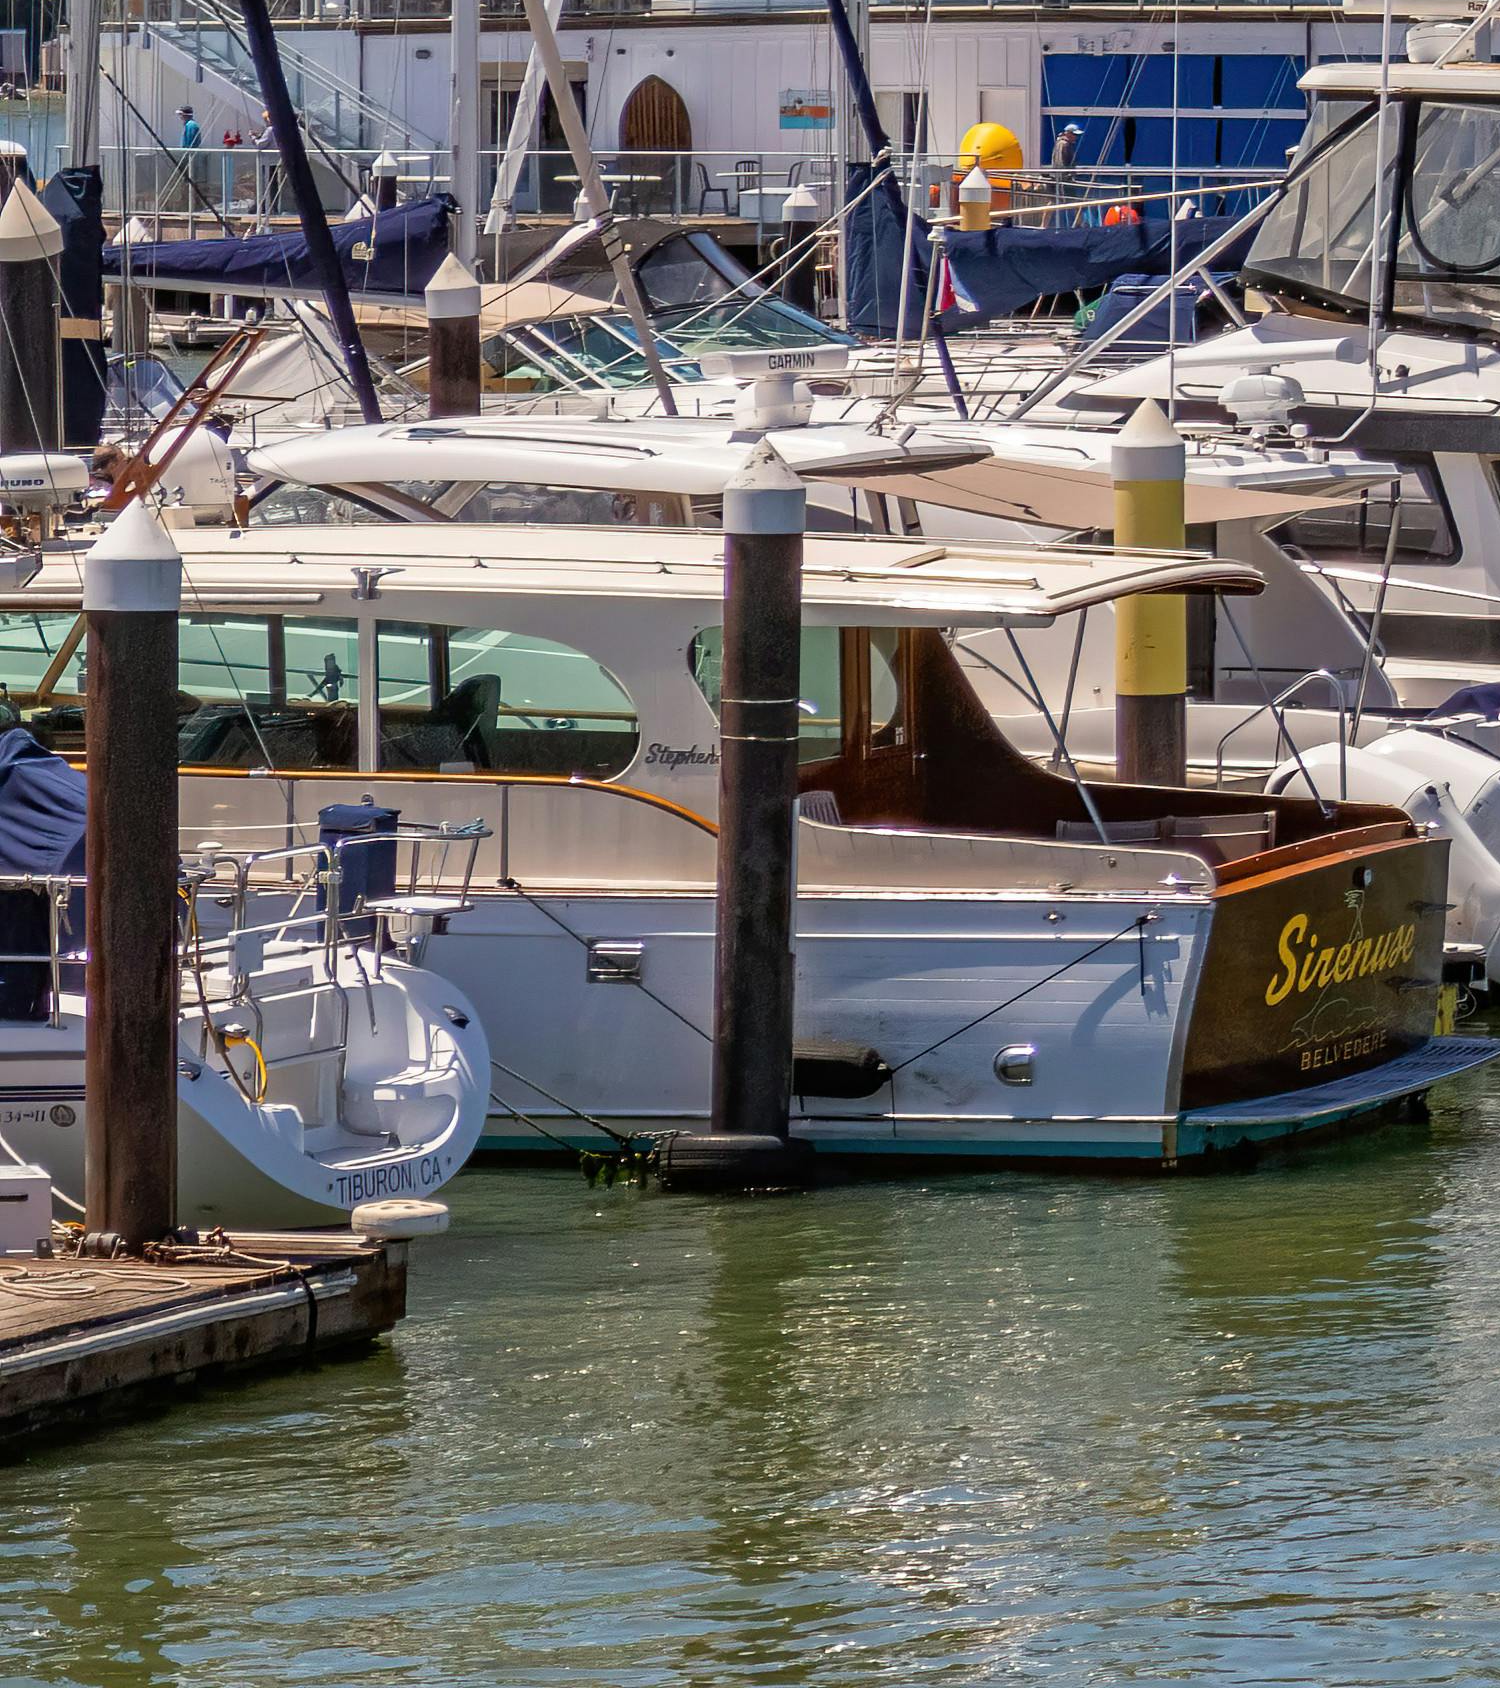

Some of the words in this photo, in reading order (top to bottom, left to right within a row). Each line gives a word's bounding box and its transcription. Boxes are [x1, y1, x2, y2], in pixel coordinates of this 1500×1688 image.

[768, 352, 815, 370] GARMIN
[1265, 913, 1416, 1006] Sirenuse
[1300, 1029, 1388, 1071] BELVEDERE
[336, 1165, 416, 1204] TIBURON,
[420, 1156, 443, 1186] CA
